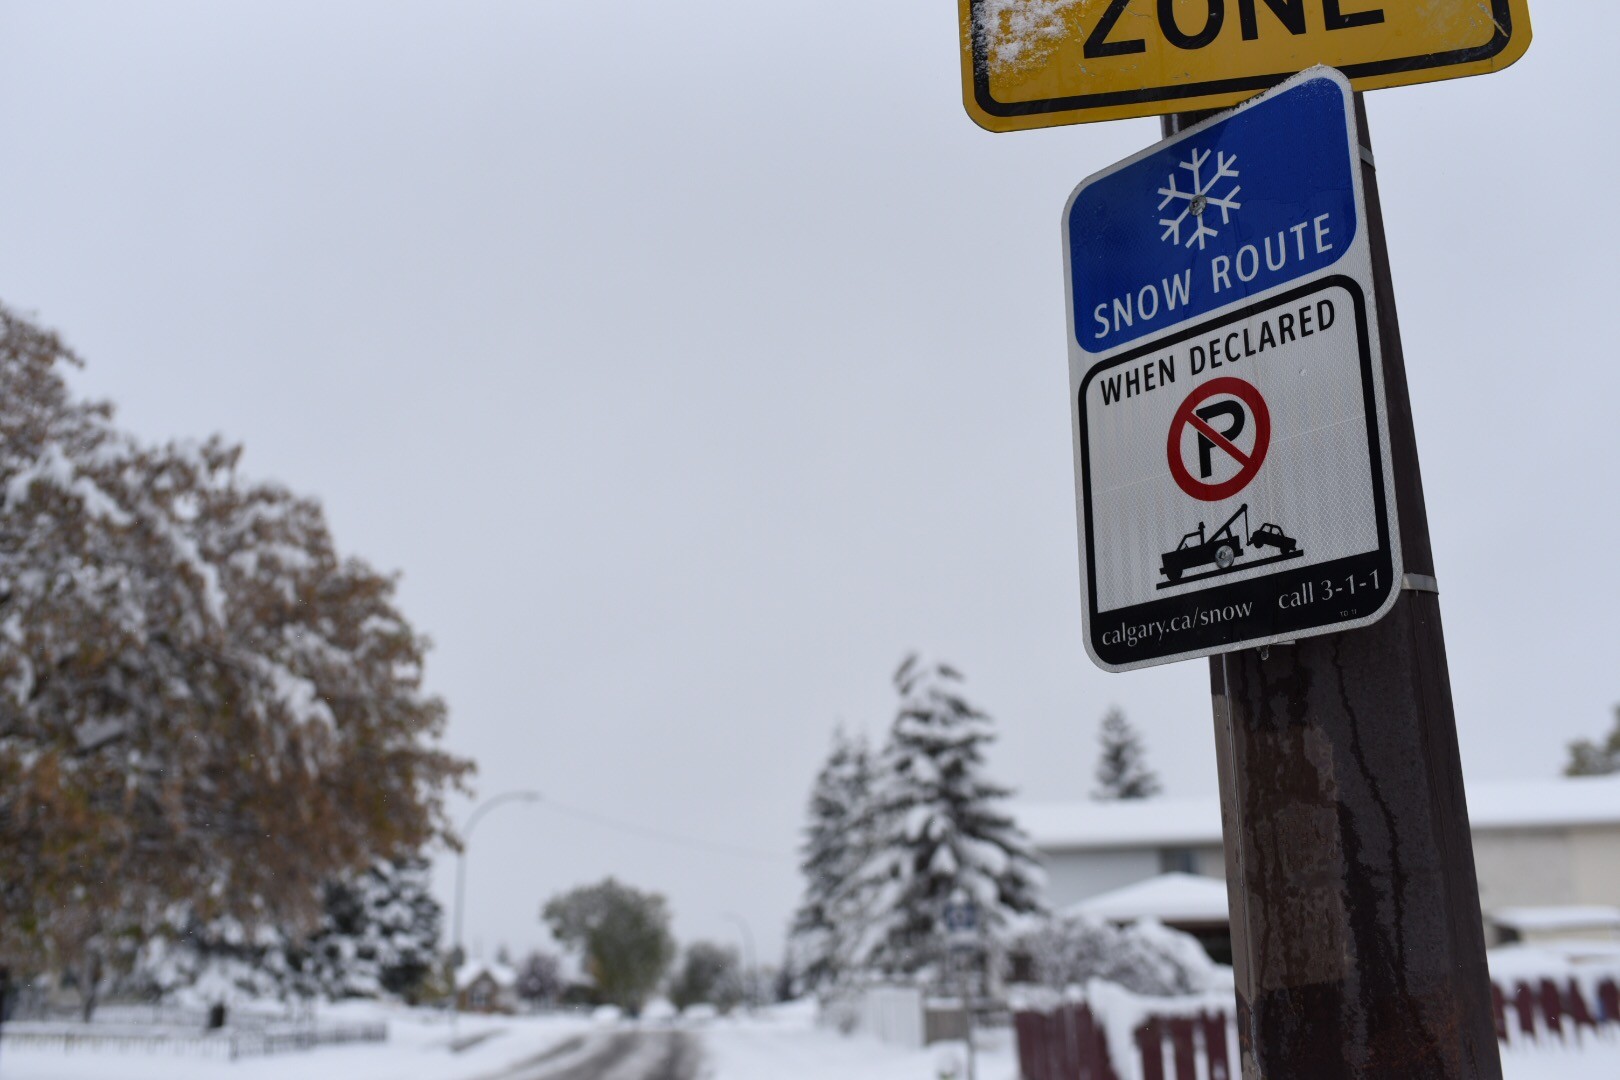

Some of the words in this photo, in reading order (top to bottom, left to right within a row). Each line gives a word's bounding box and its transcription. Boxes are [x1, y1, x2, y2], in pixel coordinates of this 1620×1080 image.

[1094, 269, 1191, 338] SNOW
[1211, 213, 1333, 293] ROUTE
[1100, 355, 1175, 406] WHEN
[1189, 299, 1336, 376] DECLARED
[1196, 400, 1245, 478] P
[1102, 602, 1253, 647] calgary.ca/snow
[1278, 581, 1314, 610] call
[1321, 569, 1380, 600] 3-1-1
